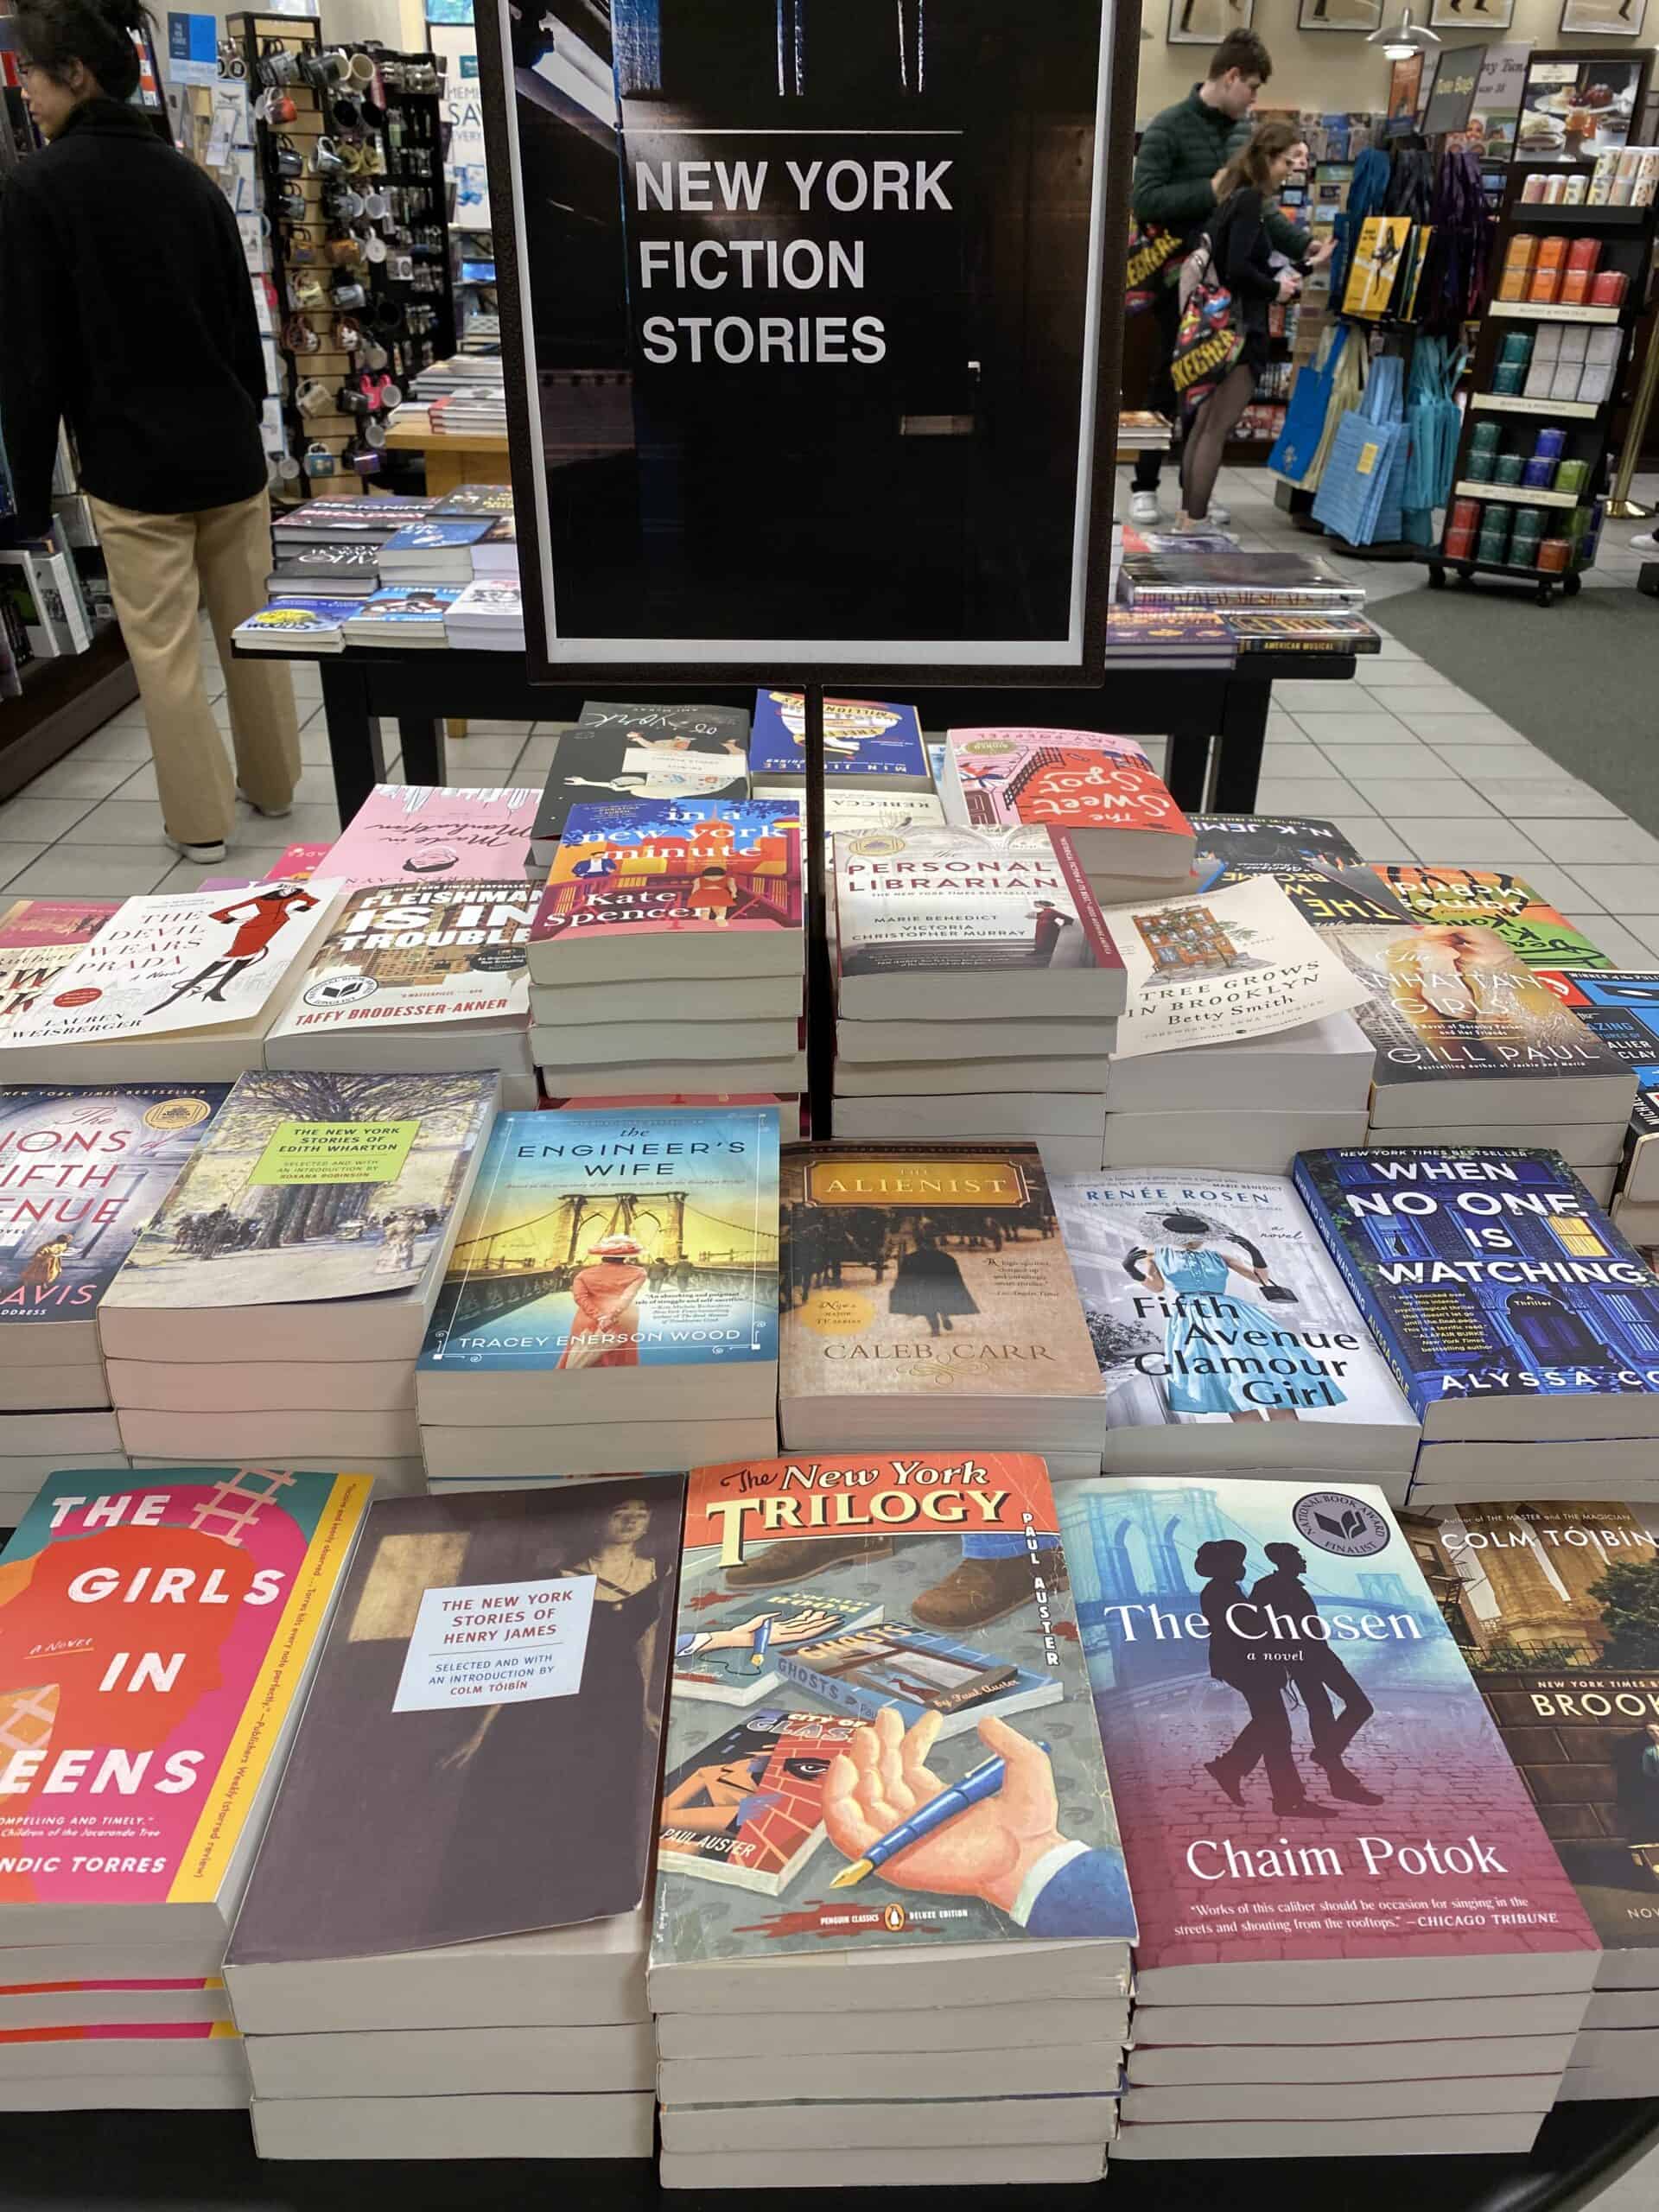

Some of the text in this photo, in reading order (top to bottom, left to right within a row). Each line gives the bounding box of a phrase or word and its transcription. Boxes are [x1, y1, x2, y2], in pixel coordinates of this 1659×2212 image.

[635, 160, 953, 212] NEW YORK
[640, 239, 865, 289] FICTION
[642, 316, 887, 365] STORIES
[1264, 642, 1334, 651] AMERICAN MUSICAL
[1039, 766, 1143, 793] Spot
[667, 807, 741, 821] in a
[832, 799, 930, 809] REBECCA
[1033, 792, 1171, 817] Sweet
[1089, 813, 1137, 823] The
[581, 824, 789, 843] new york
[603, 843, 762, 861] minute
[848, 861, 1052, 875] PERSONAL
[849, 877, 1059, 892] LIBRARIAN
[359, 890, 543, 909] FLEISHMAN
[583, 890, 677, 907] Kate
[143, 911, 206, 925] THE
[344, 905, 540, 934] IS IN
[543, 906, 711, 929] Spencer
[108, 925, 207, 941] DEVIL
[339, 927, 531, 953] TROUBLE
[852, 929, 1027, 940] CHRISTOPHER MURRAY
[91, 940, 204, 957] WEARS
[75, 954, 182, 975] PRADA
[1139, 960, 1321, 1001] TREE GROWS
[1355, 972, 1543, 991] ANHATTAN
[1126, 973, 1321, 1018] IN BROOKLYN
[295, 998, 508, 1027] TAFFY BRODESSER-AKNER
[1167, 995, 1294, 1026] Betty Smith
[1390, 997, 1514, 1015] GIRLS
[12, 1020, 143, 1038] WEISBERGER
[44, 1013, 125, 1027] LAUREN
[1387, 1044, 1601, 1064] GILL PAUL
[0, 1130, 132, 1154] IONS
[620, 1128, 651, 1137] the
[327, 1144, 398, 1153] WHARTON
[517, 1141, 747, 1158] ENGINEER'S
[0, 1164, 119, 1189] IFTH
[583, 1162, 676, 1177] WIFE
[1370, 1162, 1519, 1181] WHEN
[824, 1178, 1007, 1194] ALIENIST
[1086, 1186, 1270, 1204] RENÉE ROSEN
[1345, 1192, 1590, 1218] NO ONE
[1260, 1230, 1305, 1241] novel
[1465, 1228, 1514, 1249] IS
[1378, 1261, 1649, 1285] WATCHING
[0, 1285, 98, 1306] AVIS
[1513, 1299, 1552, 1307] Thriller
[1132, 1296, 1240, 1319] Fifth
[459, 1329, 741, 1349] TRACEY EMERSON WOOD
[1185, 1325, 1361, 1351] Avenue
[823, 1342, 1058, 1362] CALEB CARR
[1134, 1351, 1349, 1378] Glamour
[1441, 1373, 1599, 1392] ALYSSA
[1242, 1380, 1338, 1407] Girl
[721, 1460, 989, 1493] The New York
[49, 1495, 172, 1529] THE
[1299, 1495, 1386, 1537] NATIONAL BOOK AWARD
[705, 1490, 1013, 1569] TRILOGY
[1440, 1524, 1659, 1550] COLM TÓIBÍN
[1324, 1541, 1378, 1554] FINALIST
[67, 1567, 287, 1605] GIRLS
[1021, 1511, 1061, 1667] PAUL AUSTER
[442, 1590, 574, 1611] THE NEW YORK
[451, 1608, 557, 1627] STORIES OF
[1103, 1602, 1424, 1643] The Chosen
[443, 1624, 557, 1644] HENRY JAMES
[796, 1624, 917, 1661] GHOSTS
[29, 1638, 93, 1656] A NOVEL
[1246, 1649, 1305, 1662] a novel
[99, 1652, 187, 1694] IN
[435, 1654, 553, 1673] SELECTED AND WITH
[429, 1665, 554, 1685] AN INTRODUCTION BY
[778, 1658, 840, 1700] GHOSTS
[1537, 1680, 1646, 1688] NEW YORK TIMES
[450, 1685, 483, 1695] COLM
[1530, 1693, 1659, 1717] BROOK
[787, 1713, 868, 1727] CITY OF
[0, 1748, 207, 1796] EENS
[0, 1816, 65, 1826] OMPELLING
[70, 1816, 97, 1825] AND
[659, 1827, 756, 1858] PAUL AUSTER
[0, 1856, 167, 1873] NDIC TORRES
[1185, 1834, 1509, 1879] Chaim Potok
[1237, 1903, 1250, 1916] of
[1252, 1903, 1274, 1914] this
[1277, 1901, 1315, 1914] caliber
[1319, 1900, 1357, 1911] should
[1360, 1899, 1375, 1910] be
[1378, 1898, 1430, 1910] occasion
[1431, 1897, 1448, 1910] for
[1451, 1897, 1493, 1910] singing
[1494, 1897, 1508, 1908] in
[1510, 1896, 1529, 1906] the
[820, 1908, 969, 1926] PENGUIN CLASSICS DELUXE EDITION
[1174, 1924, 1213, 1936] streets
[1216, 1922, 1238, 1934] and
[1240, 1919, 1293, 1935] shouting
[1294, 1917, 1322, 1930] from
[1324, 1916, 1343, 1929] the
[1491, 1912, 1559, 1925] TRIBUNE
